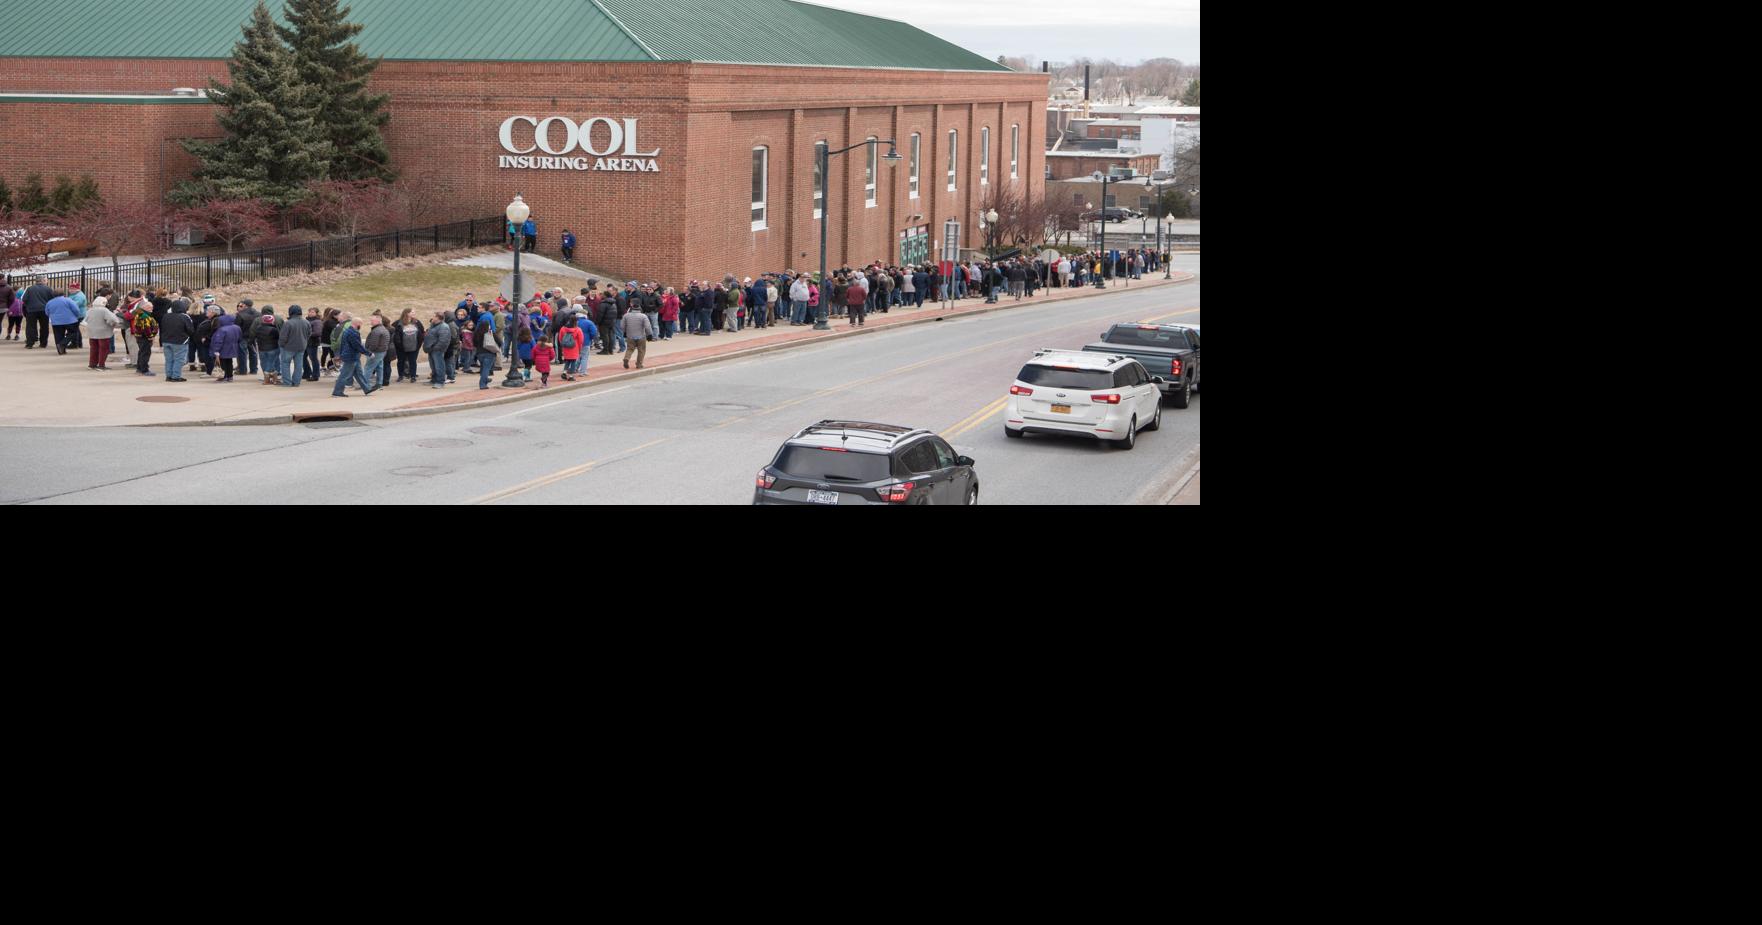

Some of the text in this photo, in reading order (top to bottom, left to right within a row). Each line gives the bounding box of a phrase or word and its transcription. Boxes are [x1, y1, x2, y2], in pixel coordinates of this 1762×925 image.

[498, 115, 661, 157] COOL
[498, 155, 660, 172] INSURING ARENA
